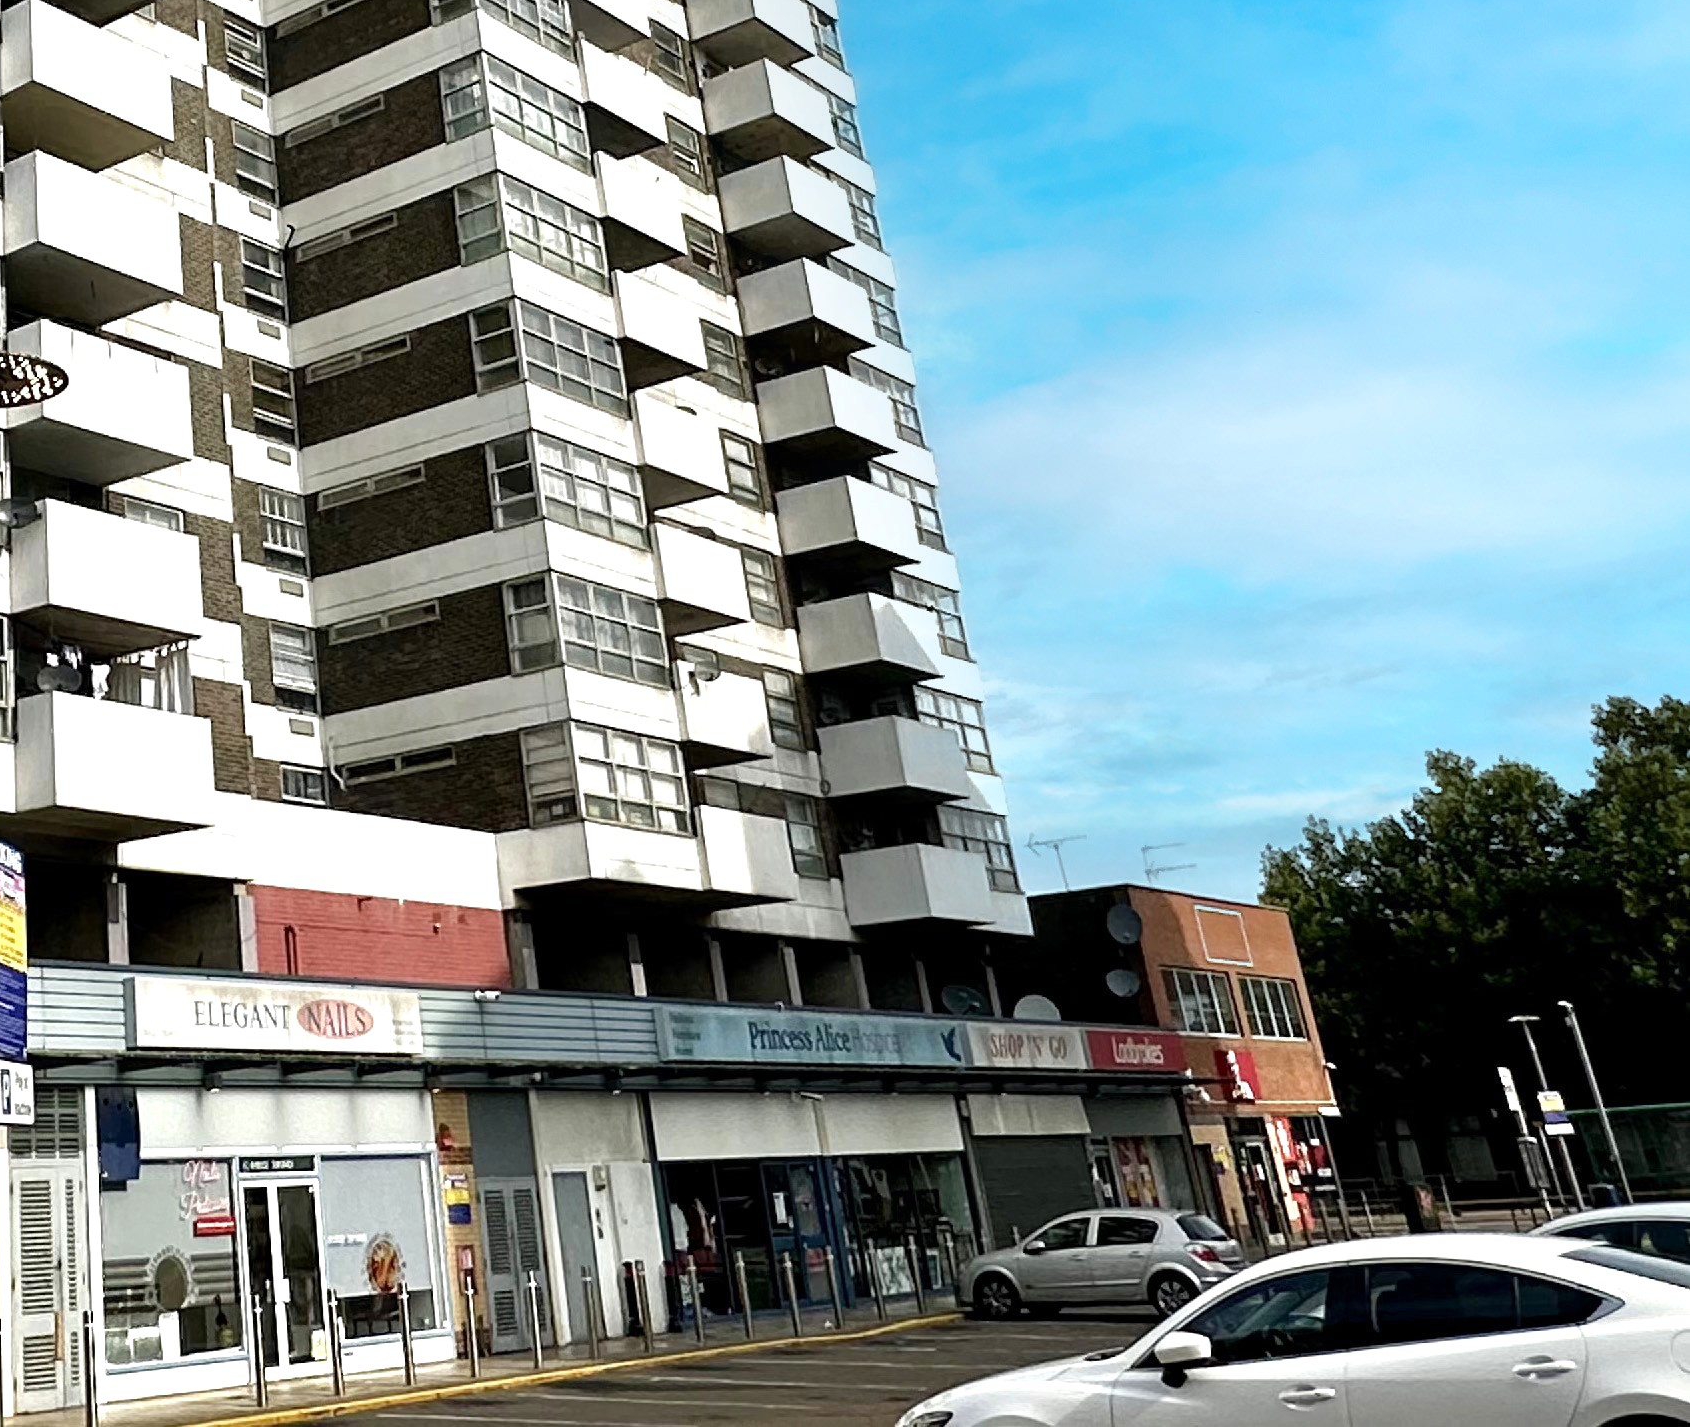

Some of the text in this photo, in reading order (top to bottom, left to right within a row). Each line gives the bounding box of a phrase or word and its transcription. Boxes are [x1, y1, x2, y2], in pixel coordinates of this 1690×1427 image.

[194, 1000, 291, 1029] ELEGANT
[308, 1002, 366, 1037] NAILS
[748, 1021, 813, 1051] Princess
[816, 1023, 851, 1052] Alice
[990, 1033, 1024, 1058] SHOP
[1048, 1036, 1068, 1060] GO
